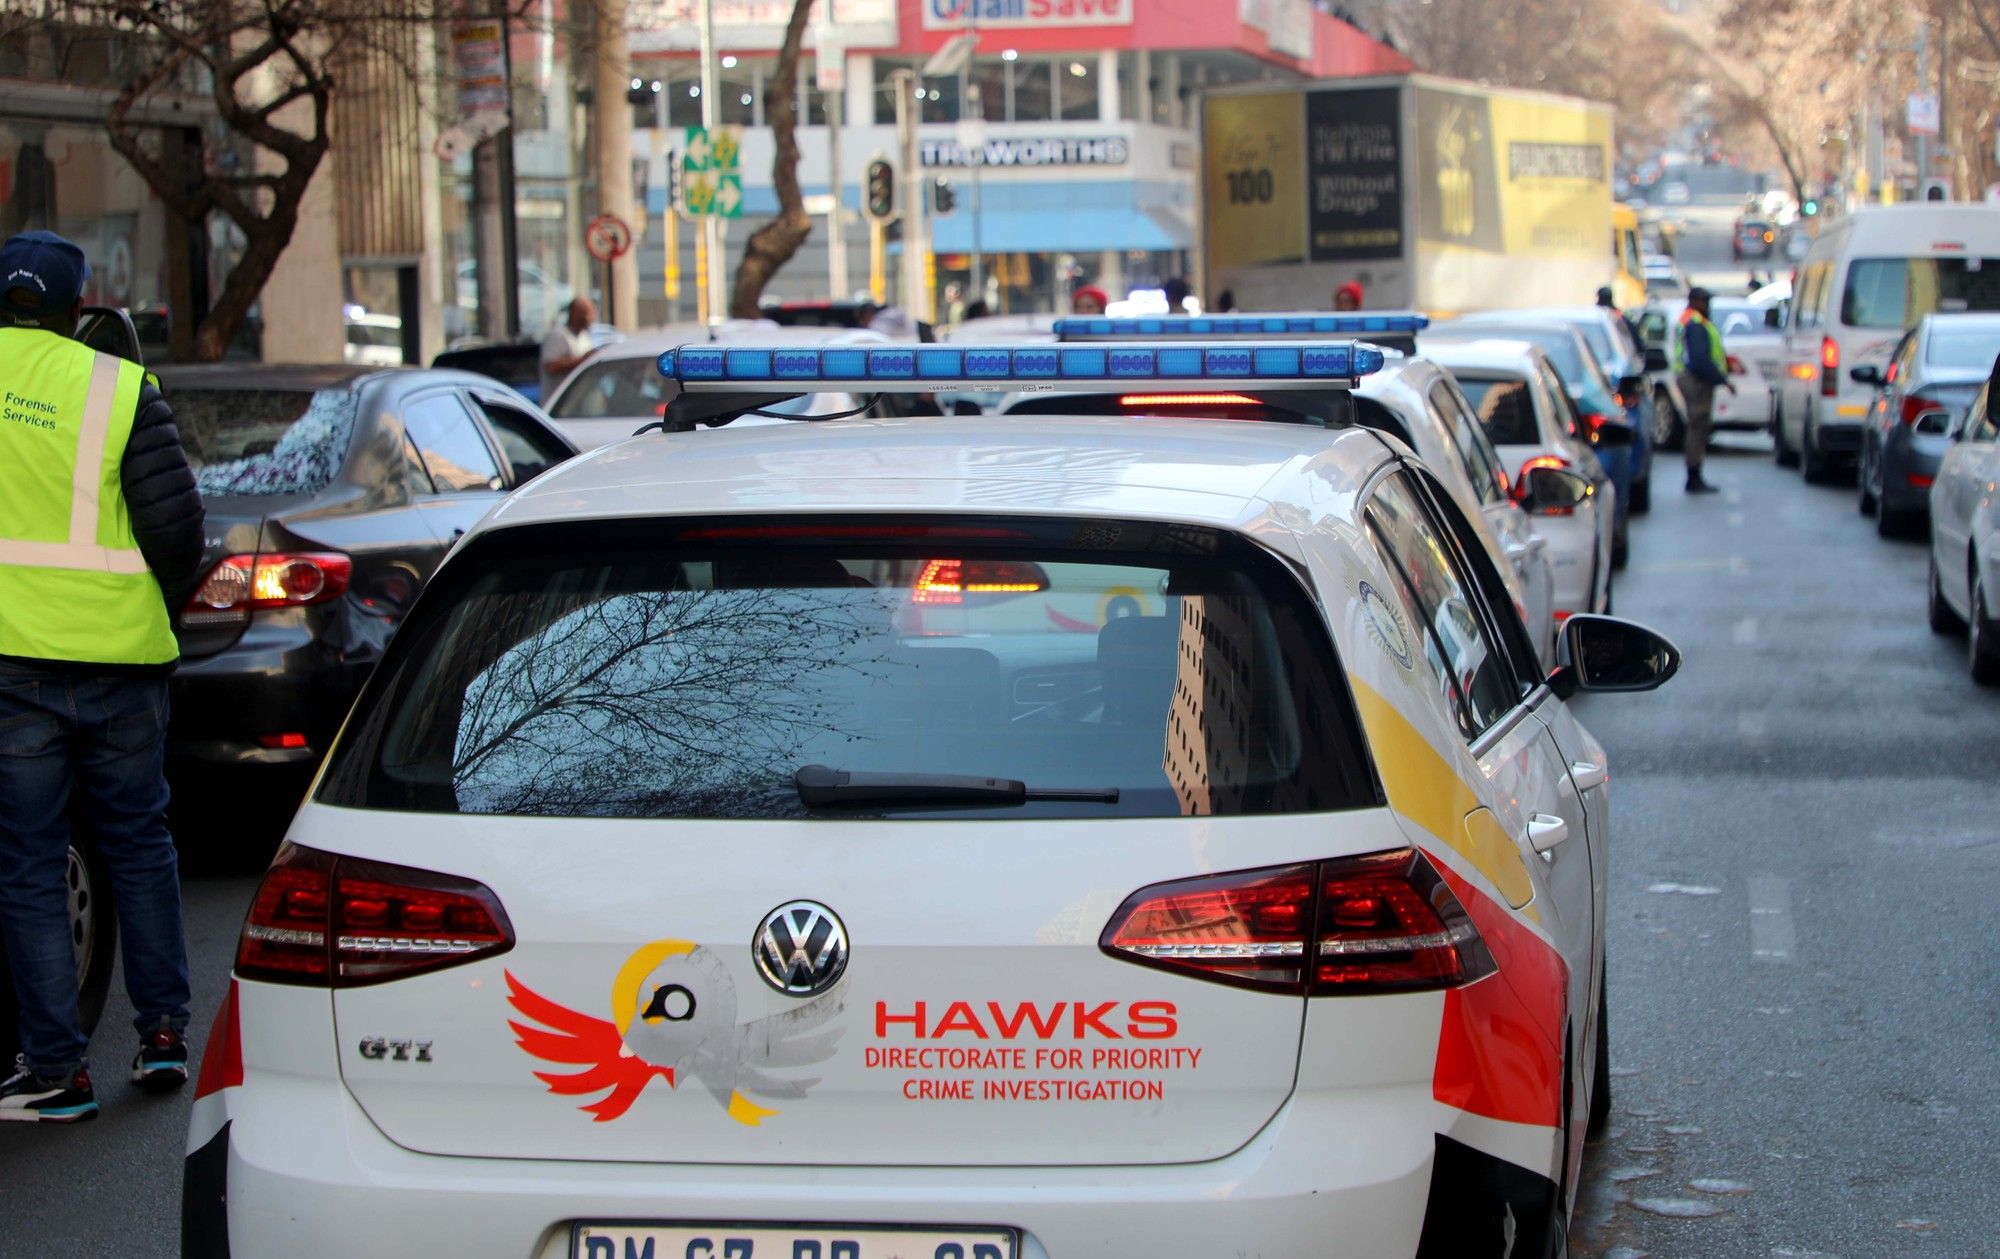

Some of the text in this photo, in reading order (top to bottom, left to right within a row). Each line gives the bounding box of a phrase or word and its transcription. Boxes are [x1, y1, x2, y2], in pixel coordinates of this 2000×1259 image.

[1226, 168, 1275, 204] 100
[1317, 174, 1396, 194] Without
[1317, 195, 1379, 216] Drugs
[5, 392, 57, 414] Forensic
[3, 408, 56, 430] Services
[875, 1001, 1178, 1039] HAWKS
[359, 1037, 434, 1062] GTI
[865, 1047, 1202, 1070] DIRECTORATE FOR PRIORITY
[903, 1079, 1163, 1101] CRIME INVESTIGATION
